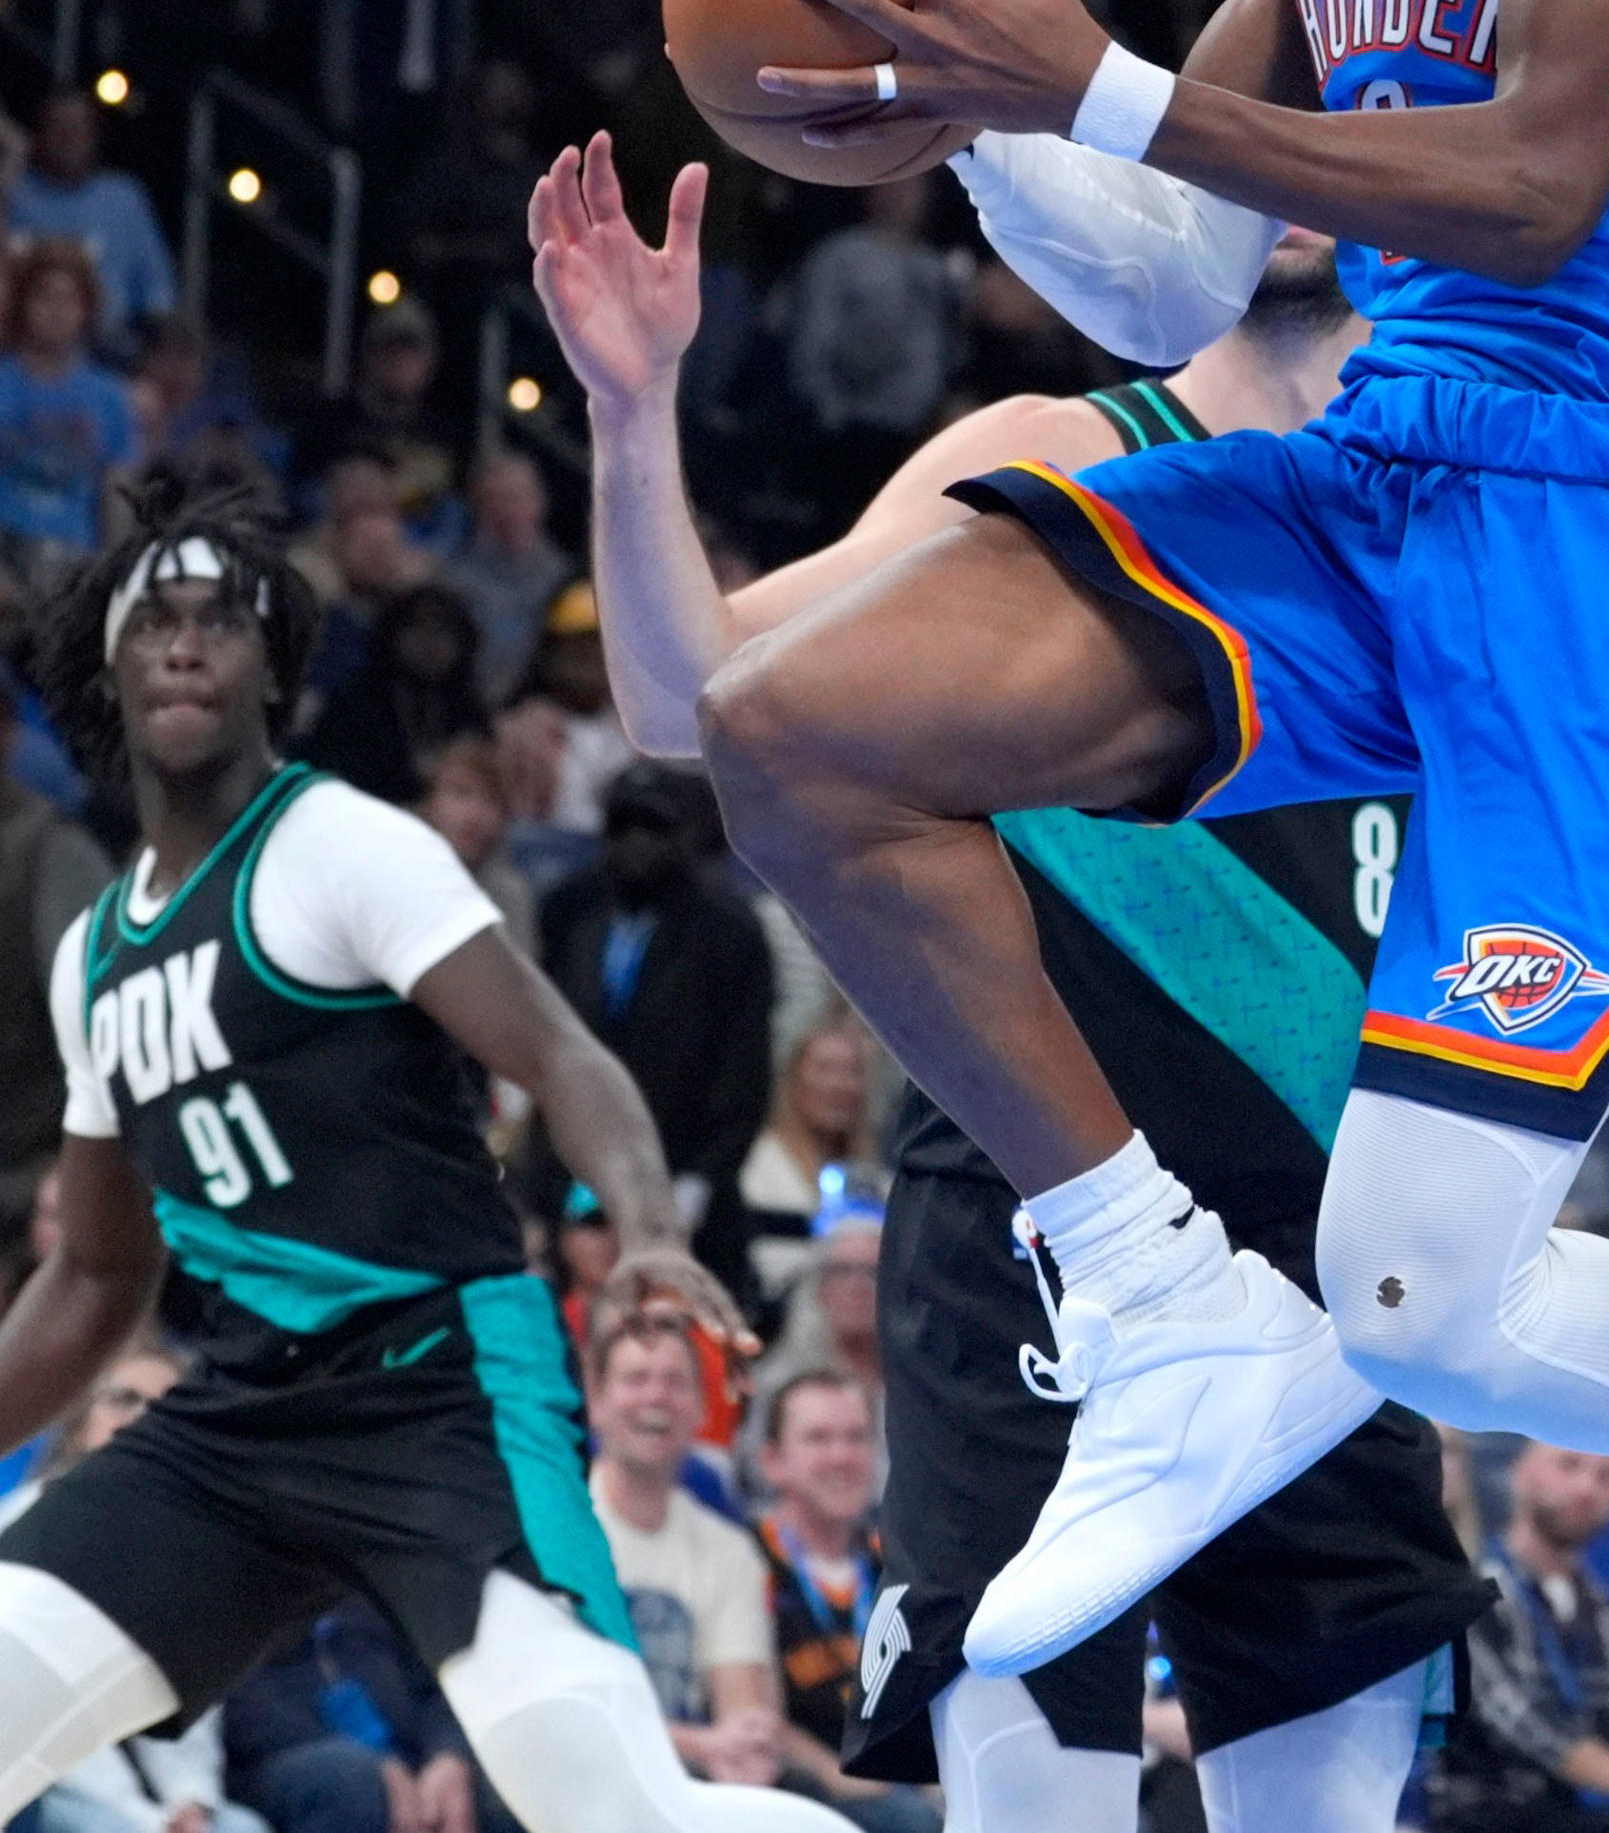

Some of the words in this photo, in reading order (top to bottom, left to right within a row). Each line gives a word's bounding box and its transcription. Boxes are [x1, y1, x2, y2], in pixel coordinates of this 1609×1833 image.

[1351, 802, 1398, 938] 8
[91, 939, 234, 1106] PDX
[1450, 954, 1563, 1001] OKC
[179, 1081, 294, 1210] 91
